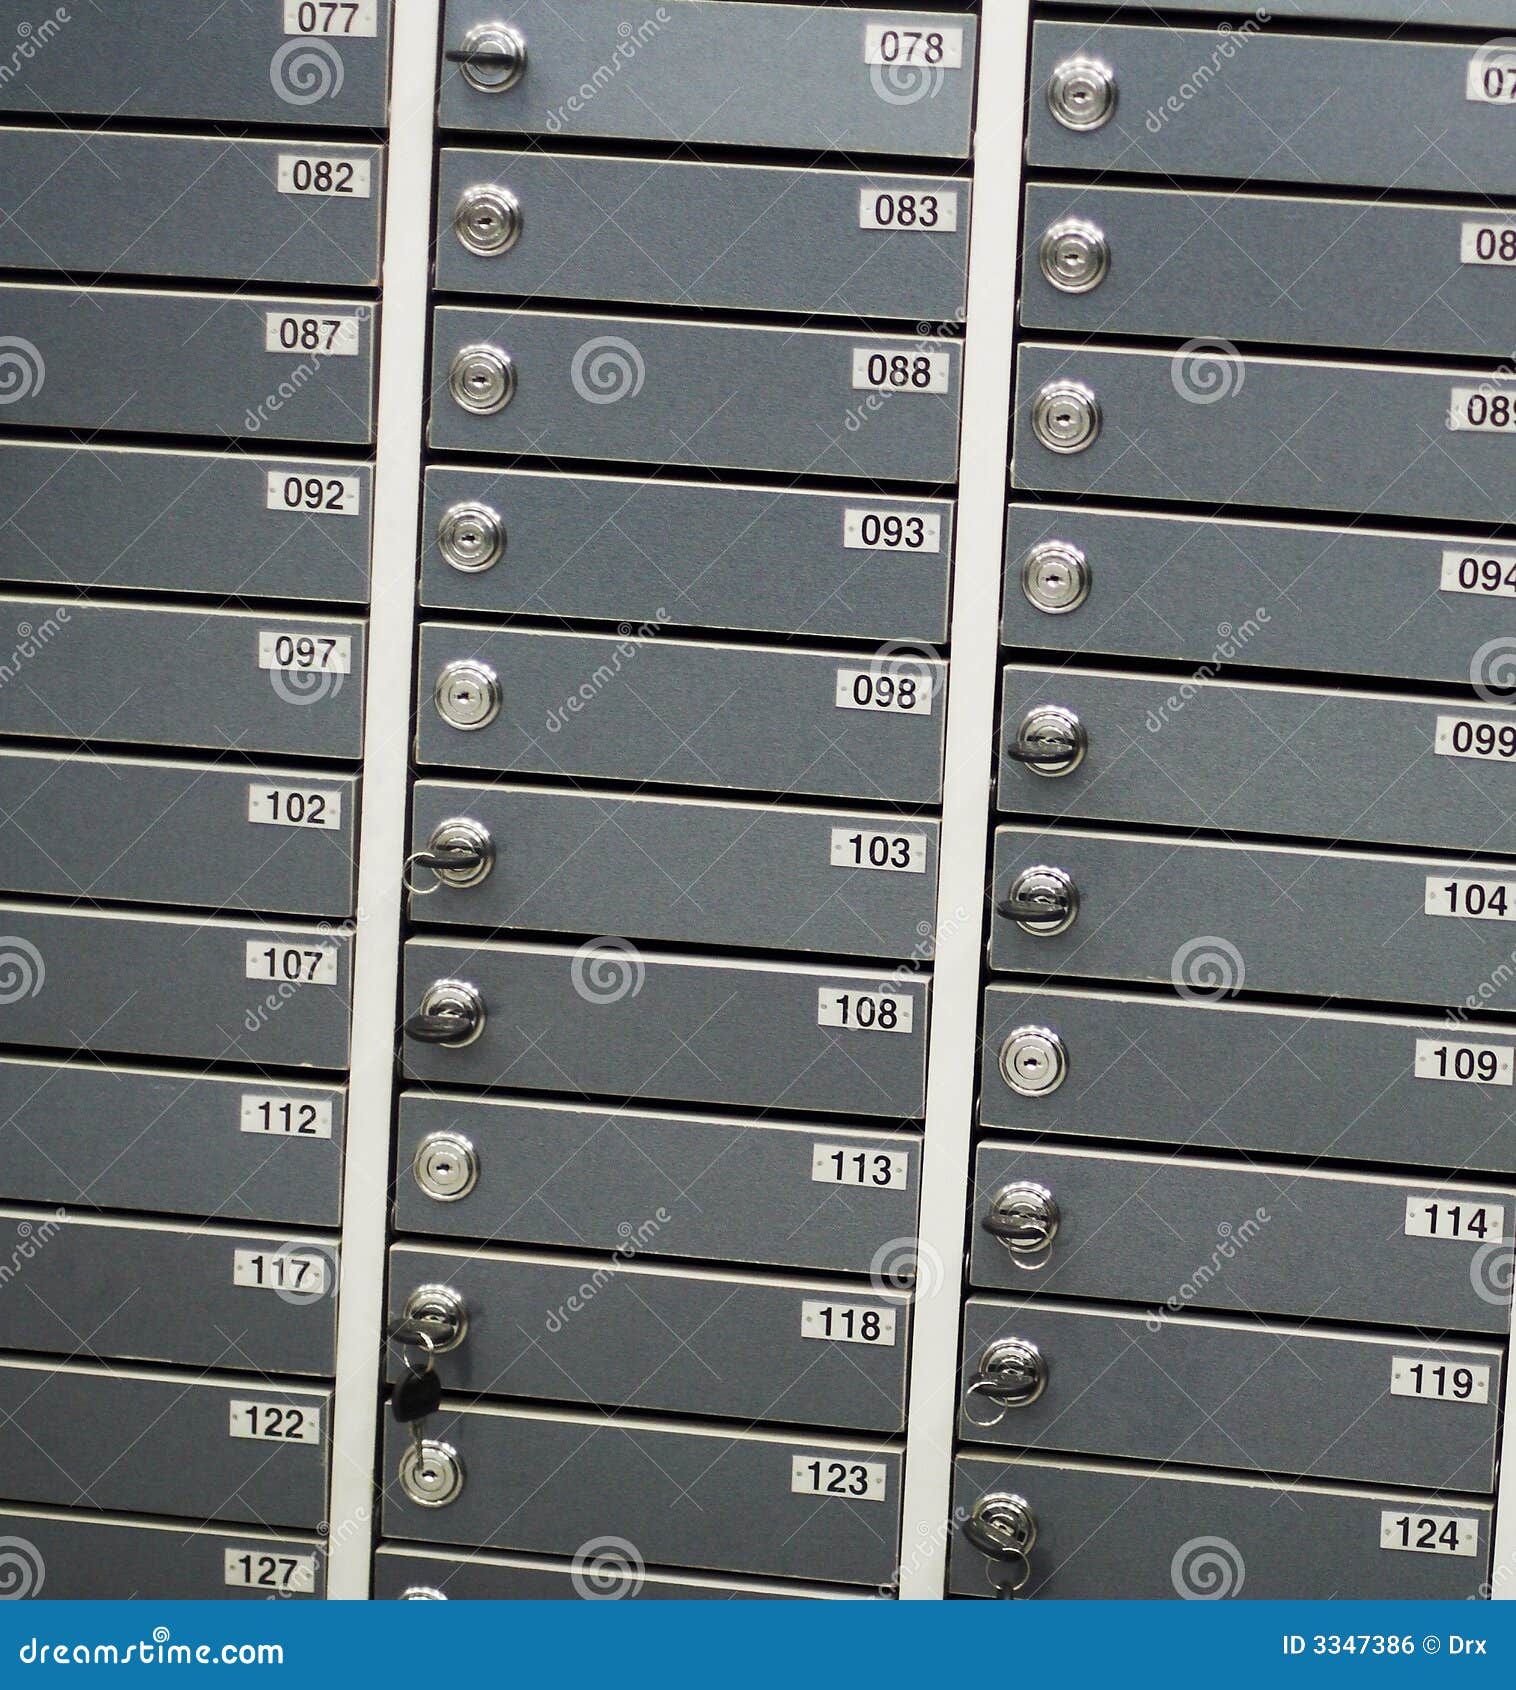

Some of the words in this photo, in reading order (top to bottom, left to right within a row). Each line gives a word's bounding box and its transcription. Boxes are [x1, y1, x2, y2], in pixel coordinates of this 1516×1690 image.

[298, 1, 359, 33] 077
[881, 30, 943, 64] 078
[1483, 66, 1516, 99] 07
[292, 159, 354, 193] 082
[875, 194, 938, 227] 083
[1476, 228, 1516, 262] 08
[280, 317, 341, 350] 087
[867, 353, 931, 388] 088
[1467, 394, 1516, 427] 08
[284, 477, 344, 510] 092
[861, 514, 924, 548] 093
[275, 635, 337, 668] 097
[853, 674, 916, 710] 098
[1452, 721, 1516, 758] 099
[266, 790, 326, 825] 102
[849, 834, 910, 869] 103
[1444, 882, 1508, 917] 104
[263, 947, 323, 981] 107
[836, 994, 898, 1030] 108
[1433, 1046, 1498, 1082] 109
[258, 1101, 317, 1135] 112
[830, 1150, 892, 1186] 113
[1424, 1203, 1488, 1239] 114
[251, 1255, 311, 1288] 117
[819, 1306, 881, 1342] 118
[1410, 1363, 1473, 1399] 119
[245, 1405, 304, 1440] 122
[807, 1461, 868, 1496] 123
[1396, 1516, 1460, 1551] 124
[238, 1554, 298, 1587] 127
